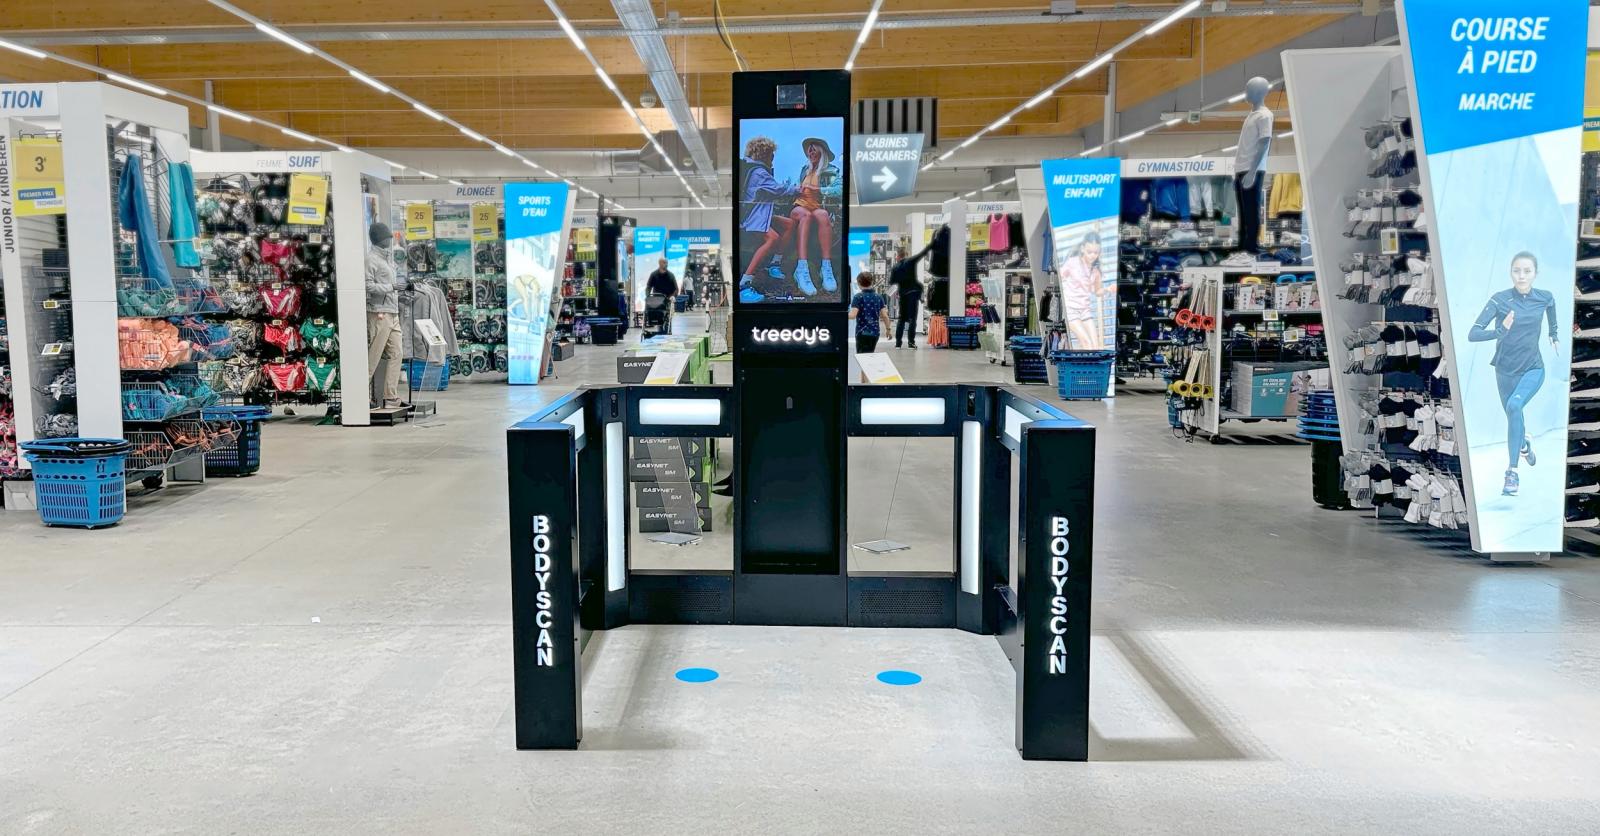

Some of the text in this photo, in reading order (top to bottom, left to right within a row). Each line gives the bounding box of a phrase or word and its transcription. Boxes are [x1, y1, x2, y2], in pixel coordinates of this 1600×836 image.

[1451, 17, 1550, 42] COURSE
[1457, 45, 1538, 74] À PIED
[0, 90, 43, 109] TION
[1458, 92, 1536, 111] MARCHE
[865, 138, 909, 149] CABINES
[289, 156, 320, 167] SURF
[855, 150, 919, 162] PASKAMERS
[1138, 161, 1215, 173] GYMNASTIQUE
[1053, 173, 1116, 185] MULTISPORT
[456, 187, 496, 196] PLONGÉE
[1064, 188, 1104, 199] ENFANT
[518, 196, 551, 205] SPORTS
[523, 207, 547, 217] D'EAU
[2, 207, 15, 253] JUNIOR
[752, 326, 829, 345] treedy's
[532, 514, 553, 666] BODYSCAN
[1049, 516, 1070, 674] BODYSCAN
